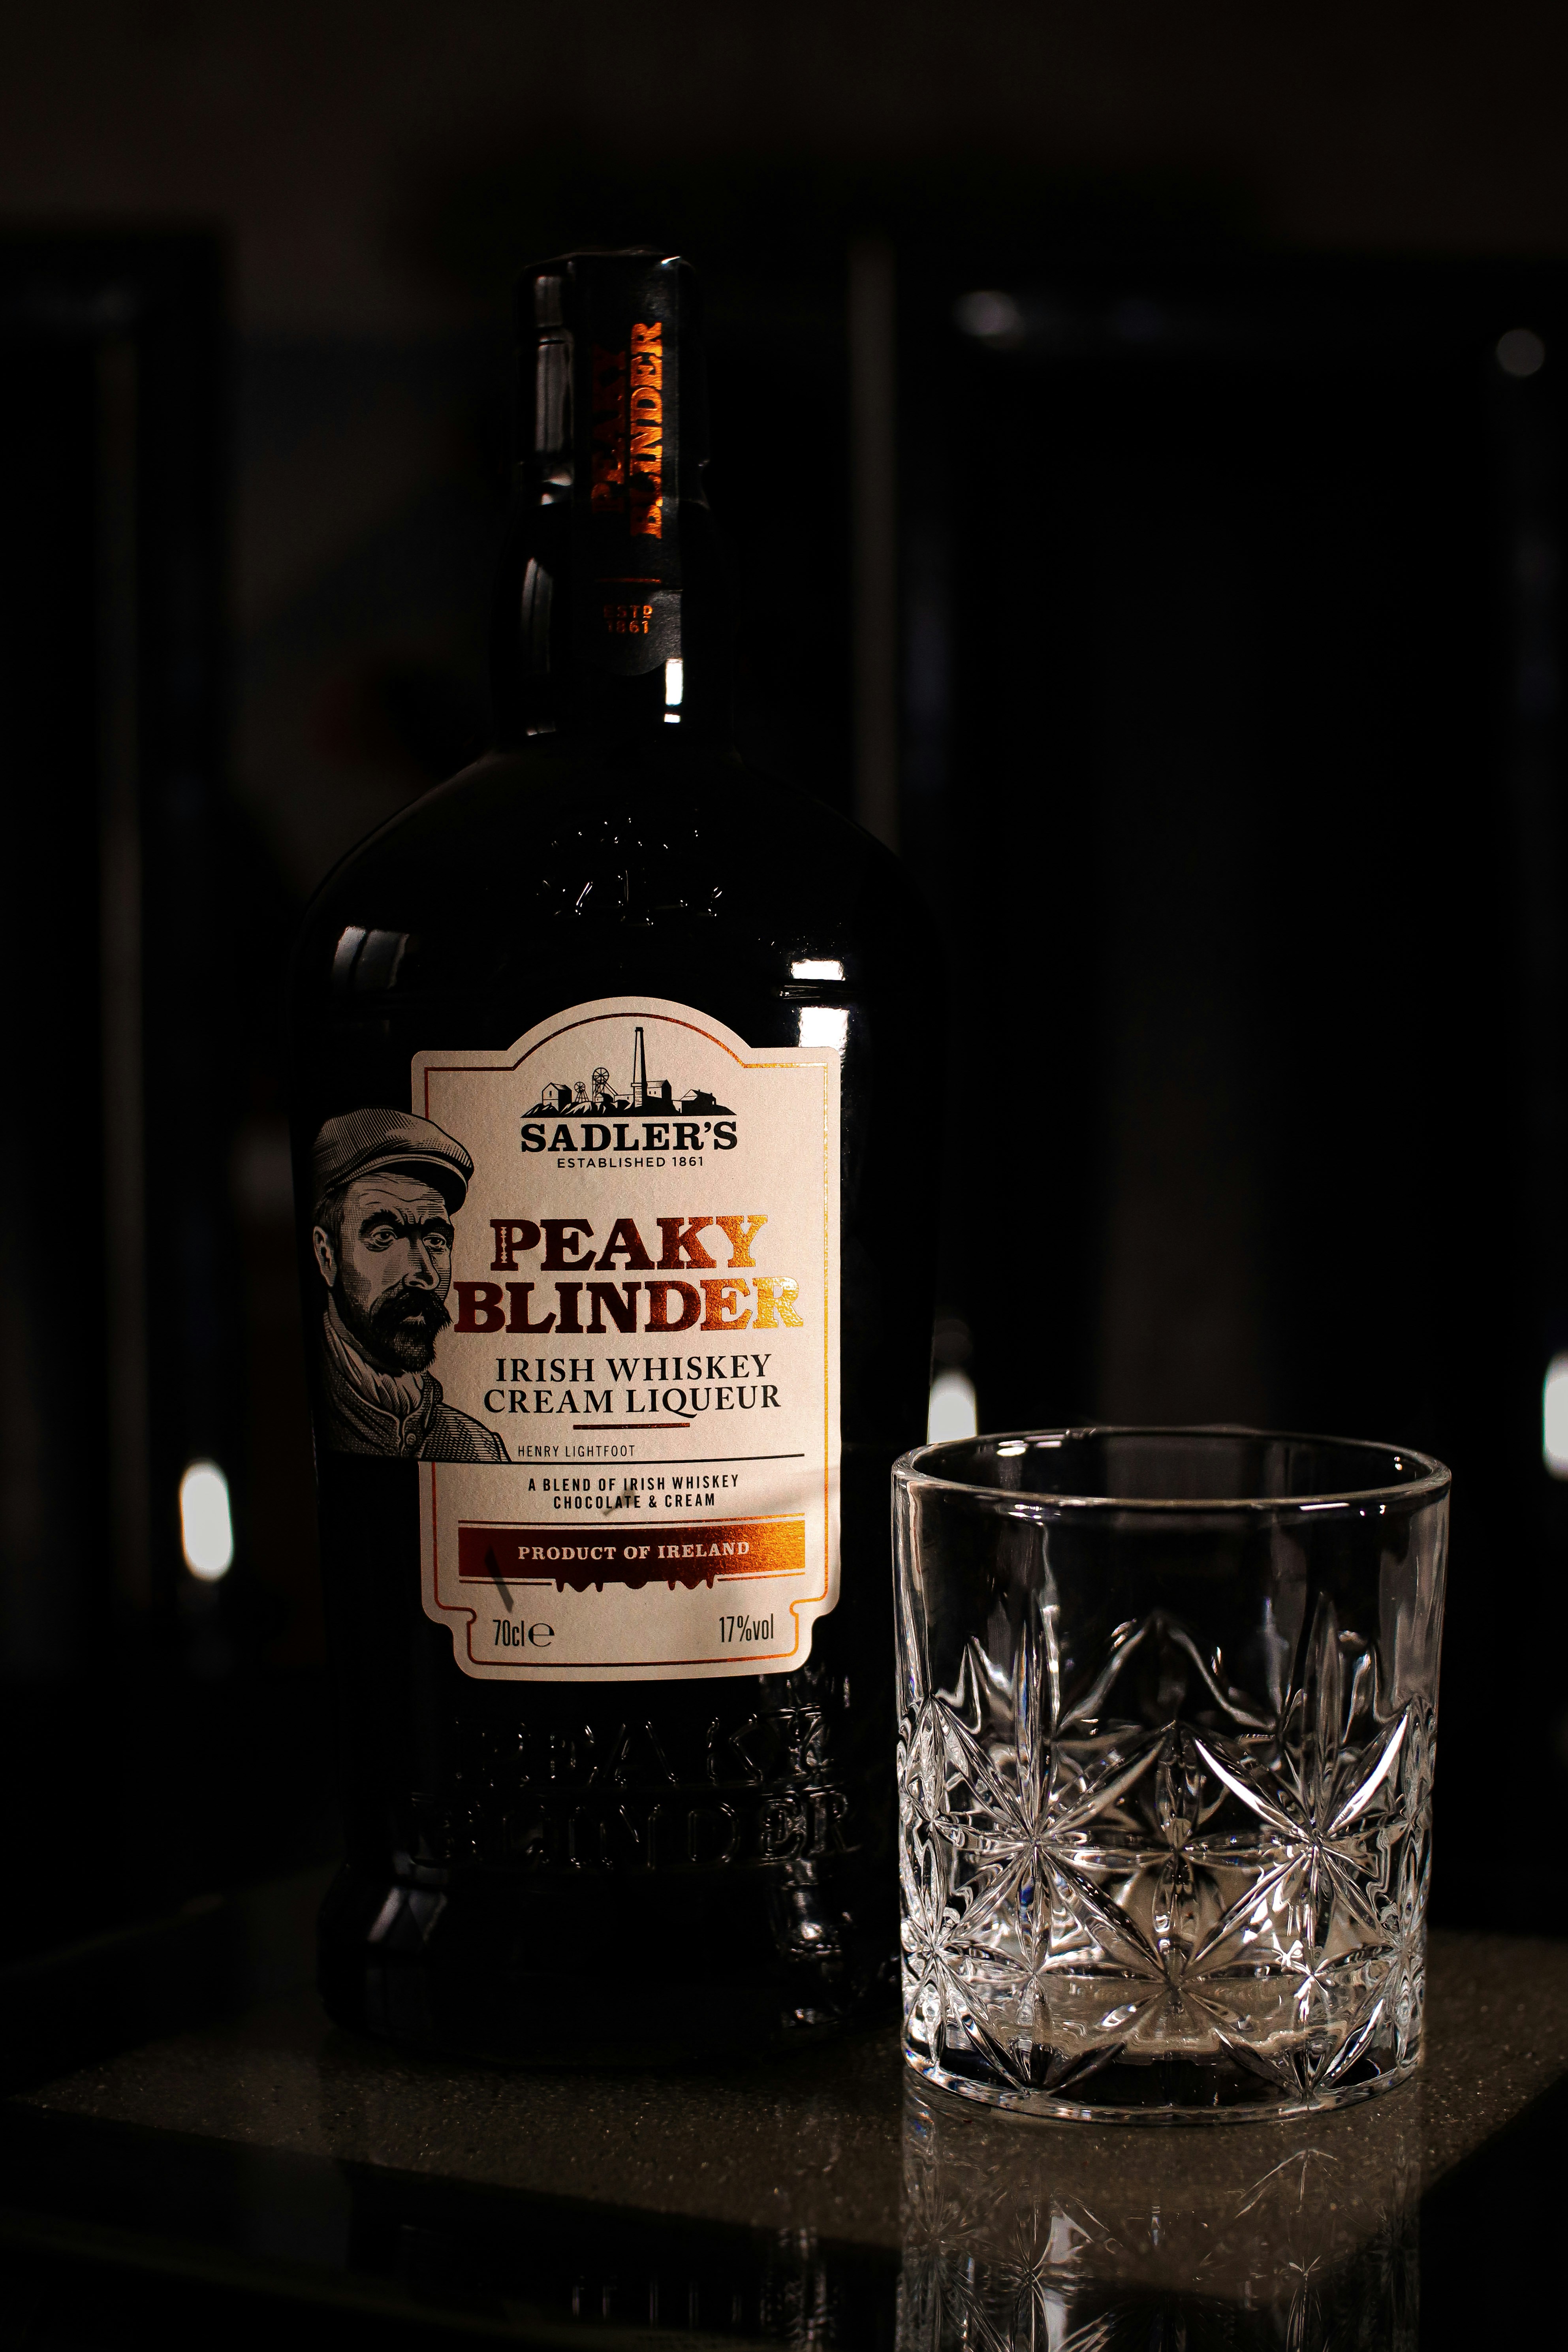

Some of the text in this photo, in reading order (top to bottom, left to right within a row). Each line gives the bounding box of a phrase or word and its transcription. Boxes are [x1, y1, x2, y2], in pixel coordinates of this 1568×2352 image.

[592, 342, 626, 514] PEAKY
[630, 321, 663, 539] BLINDER
[607, 620, 649, 634] 1861
[521, 1121, 738, 1152] SADLER'S
[557, 1156, 703, 1168] ESTABLISHED 1861
[490, 1215, 767, 1271] PEAKY
[453, 1277, 803, 1333] BLINDER
[496, 1354, 772, 1382] IRISH WHISKEY
[484, 1385, 782, 1418] CREAM LIQUEUR
[518, 1445, 635, 1457] HENRY LIGHTFOOT
[528, 1474, 739, 1491] A BLEND OF IRISH WHISKEY
[554, 1493, 715, 1509] CHOCOLATE & CREAM
[518, 1542, 750, 1560] PRODUCT OF IRELAND
[493, 1619, 525, 1647] 70cl
[719, 1613, 773, 1643] 17%vol
